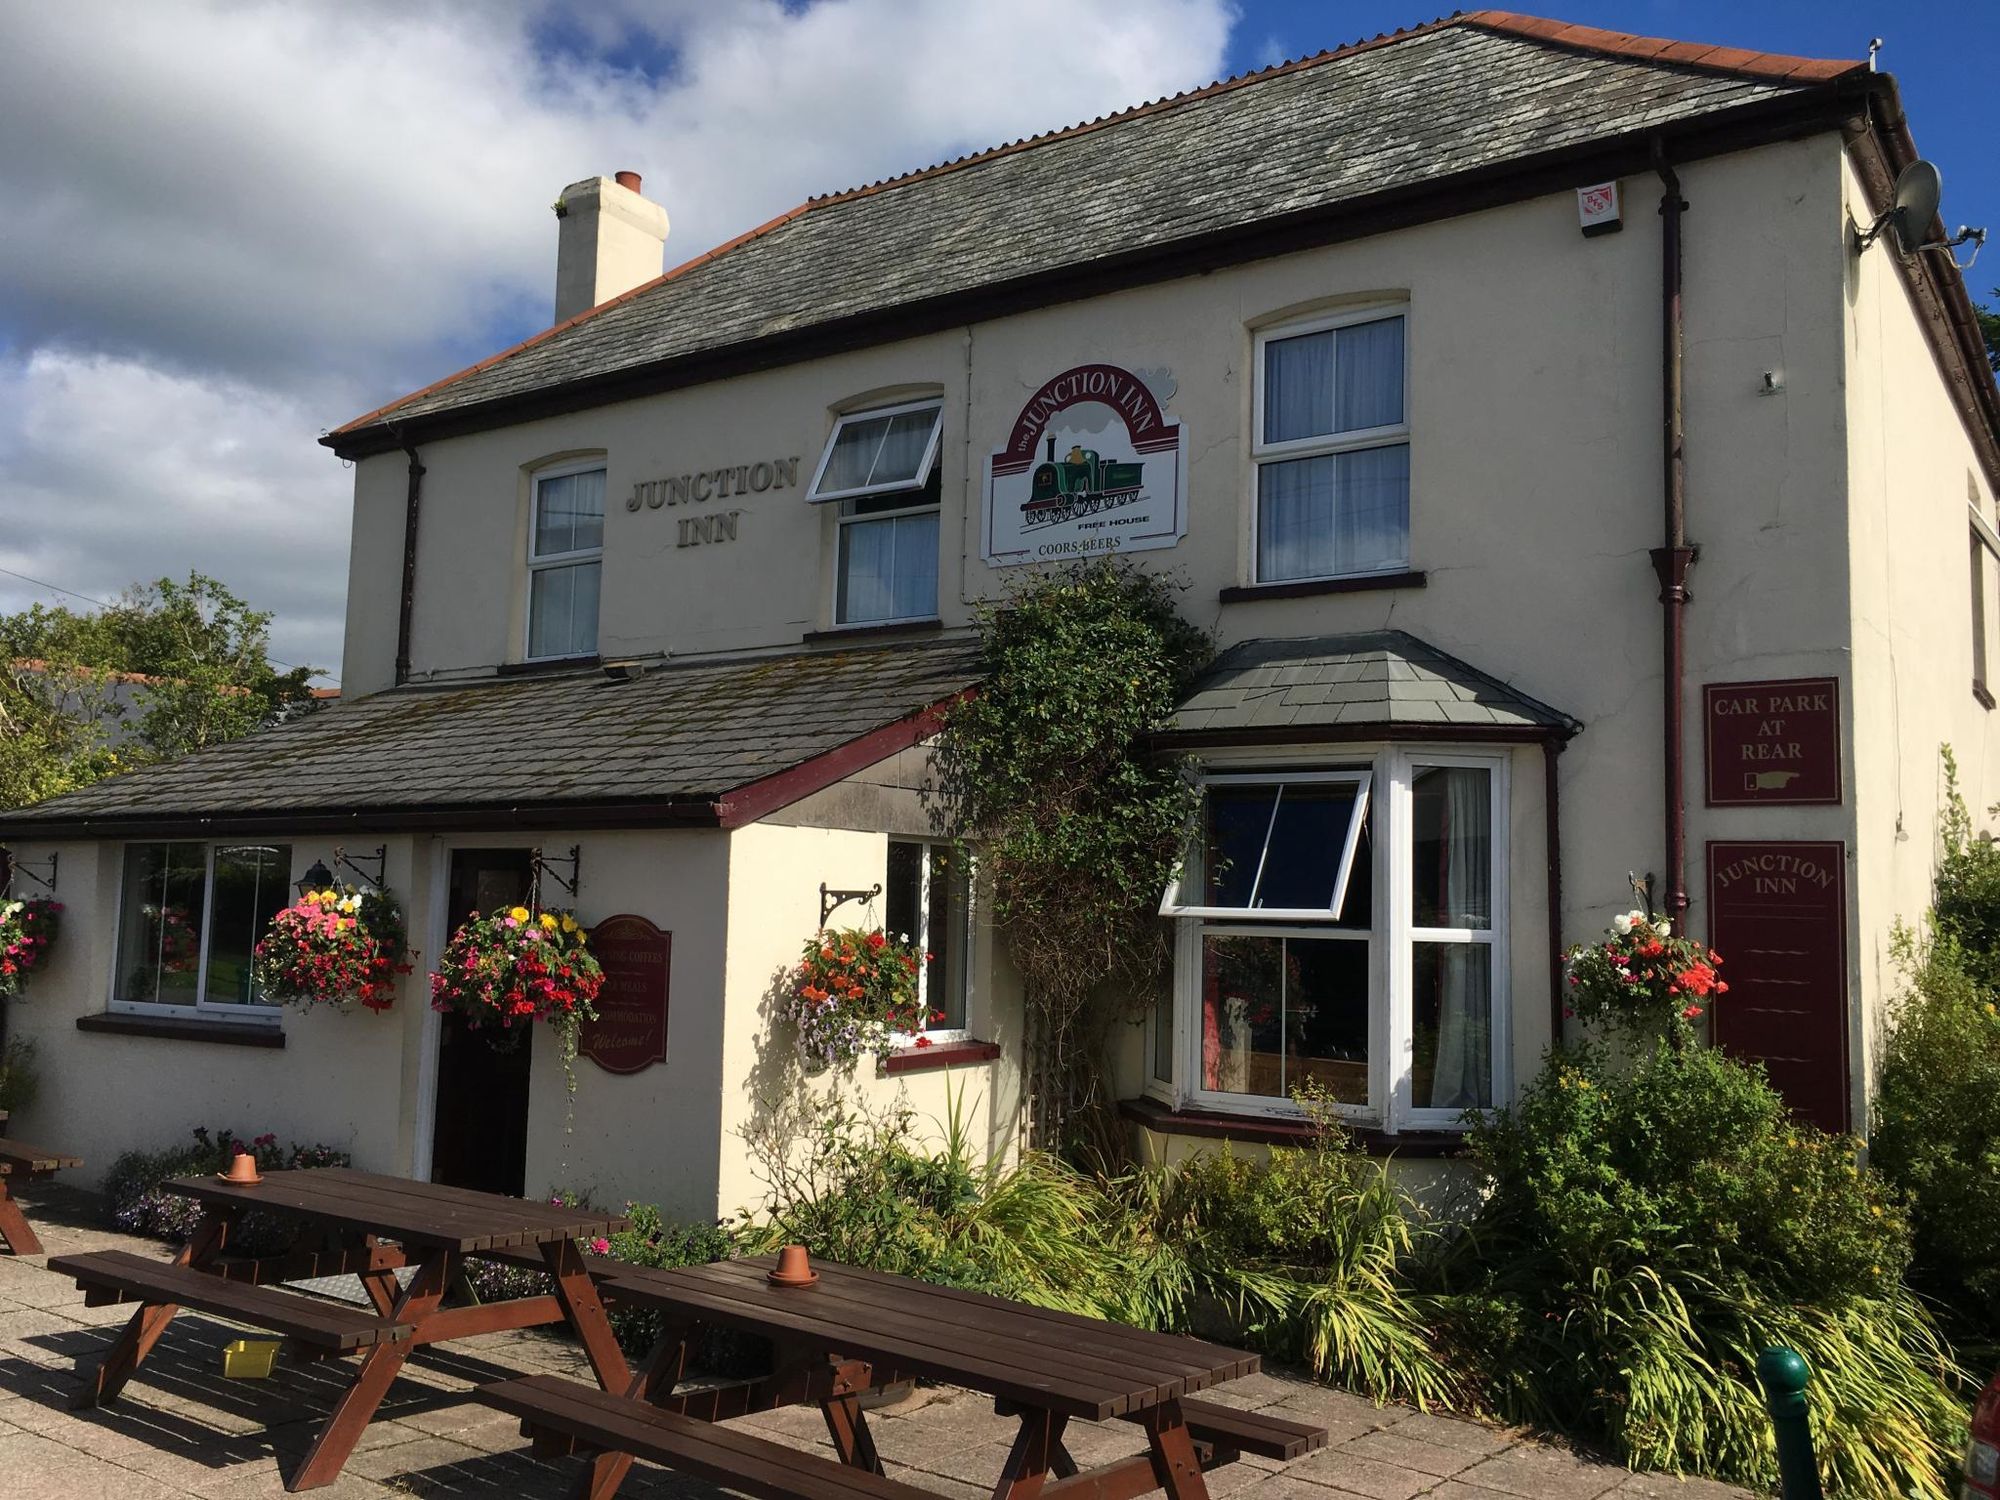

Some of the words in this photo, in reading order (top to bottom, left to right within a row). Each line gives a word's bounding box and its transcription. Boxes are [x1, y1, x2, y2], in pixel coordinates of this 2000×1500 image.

[1023, 371, 1122, 437] JUNCTION
[1121, 385, 1155, 434] INN
[1018, 433, 1031, 452] the
[626, 456, 801, 512] JUNCTION
[677, 511, 740, 548] INN
[1077, 520, 1106, 531] FREE
[1109, 515, 1150, 527] HOUSE
[1038, 541, 1078, 556] COORS
[1081, 536, 1121, 552] BEERS
[1714, 698, 1760, 716] CAR
[1769, 694, 1829, 713] PARK
[1757, 720, 1786, 737] AT
[1741, 742, 1803, 761] REAR
[1716, 854, 1835, 889] JUNCTION
[1754, 877, 1797, 894] INN
